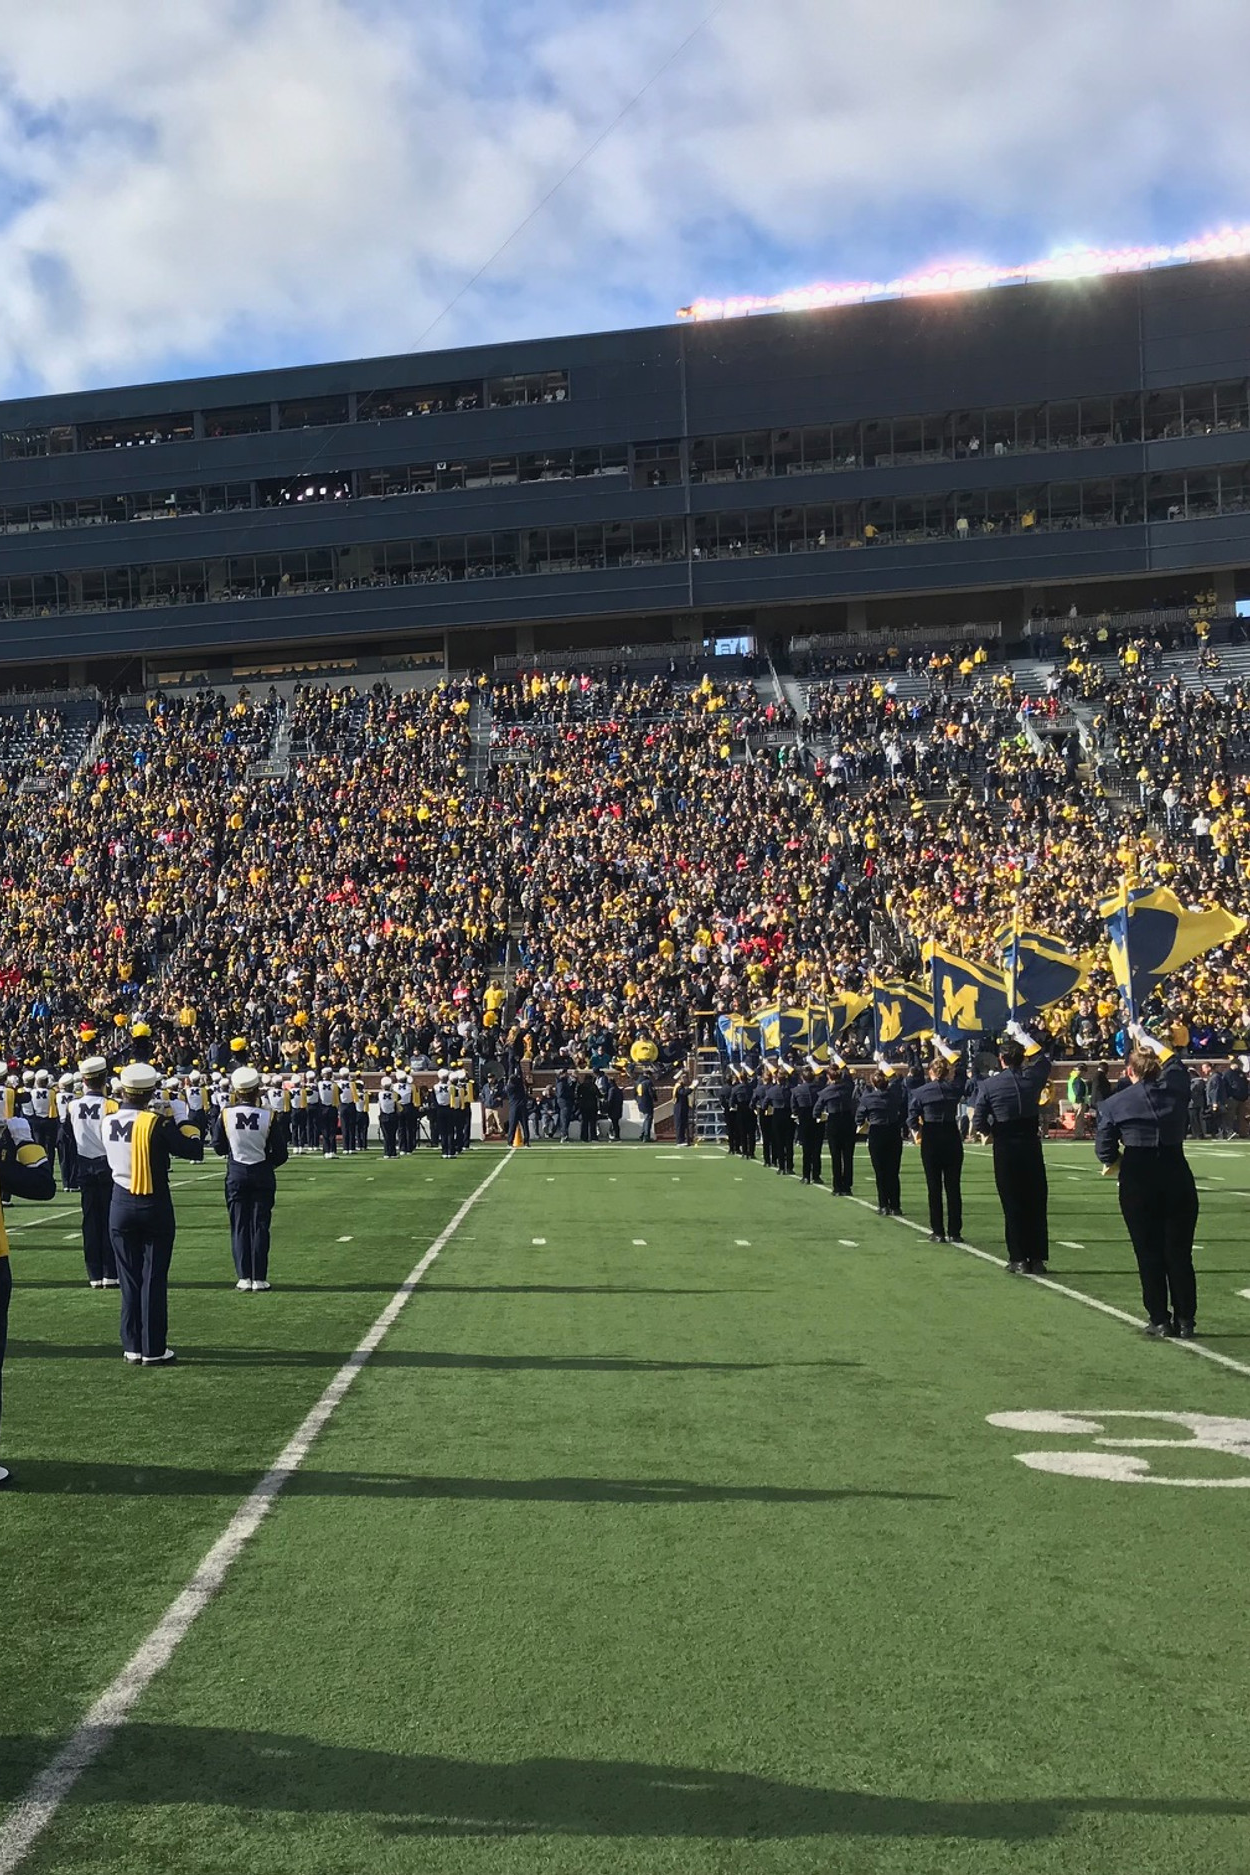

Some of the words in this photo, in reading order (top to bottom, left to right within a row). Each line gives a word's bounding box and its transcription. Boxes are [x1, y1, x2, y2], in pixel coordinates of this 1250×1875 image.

[941, 975, 983, 1031] M
[36, 1090, 47, 1099] M
[221, 1094, 230, 1102] M
[78, 1103, 101, 1120] M
[235, 1112, 260, 1130] M
[109, 1119, 134, 1142] M
